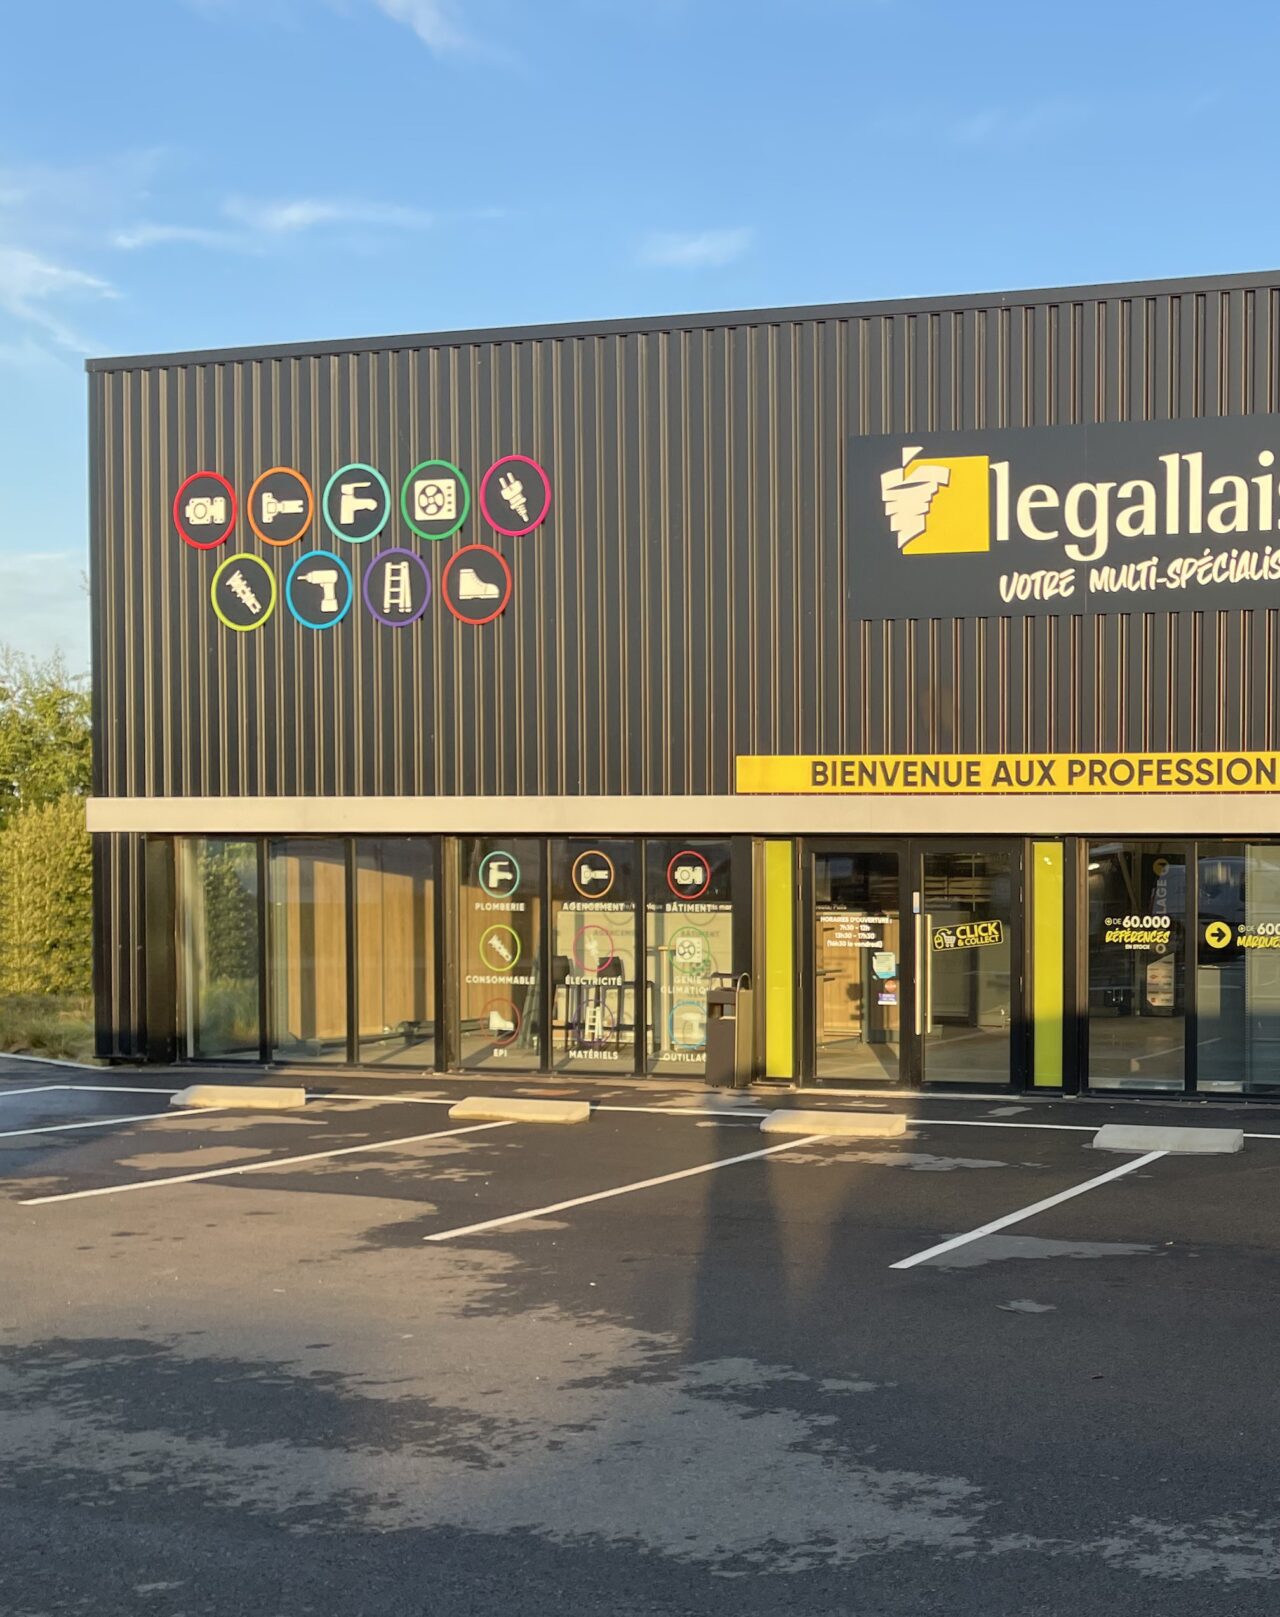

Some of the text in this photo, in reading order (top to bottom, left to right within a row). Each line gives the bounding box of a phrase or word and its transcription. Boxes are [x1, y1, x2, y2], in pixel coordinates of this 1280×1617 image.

[999, 567, 1076, 603] VOTRE
[811, 759, 982, 787] BIENVENUE
[991, 758, 1057, 786] AUX
[474, 902, 525, 912] PLOMBERIE
[562, 902, 625, 912] AGENCEMENT
[665, 902, 712, 913] BÂTIMENT
[1122, 915, 1171, 929] 60.000
[956, 923, 998, 939] CLICK
[1105, 928, 1171, 944] RÉFÉRENCES
[957, 935, 1000, 947] & COLLECT
[465, 975, 535, 986] CONSOMMABLE
[565, 975, 622, 986] ÉLECTRICITÉ
[493, 1049, 508, 1058] EPI
[569, 1049, 619, 1061] MATÉRIELS
